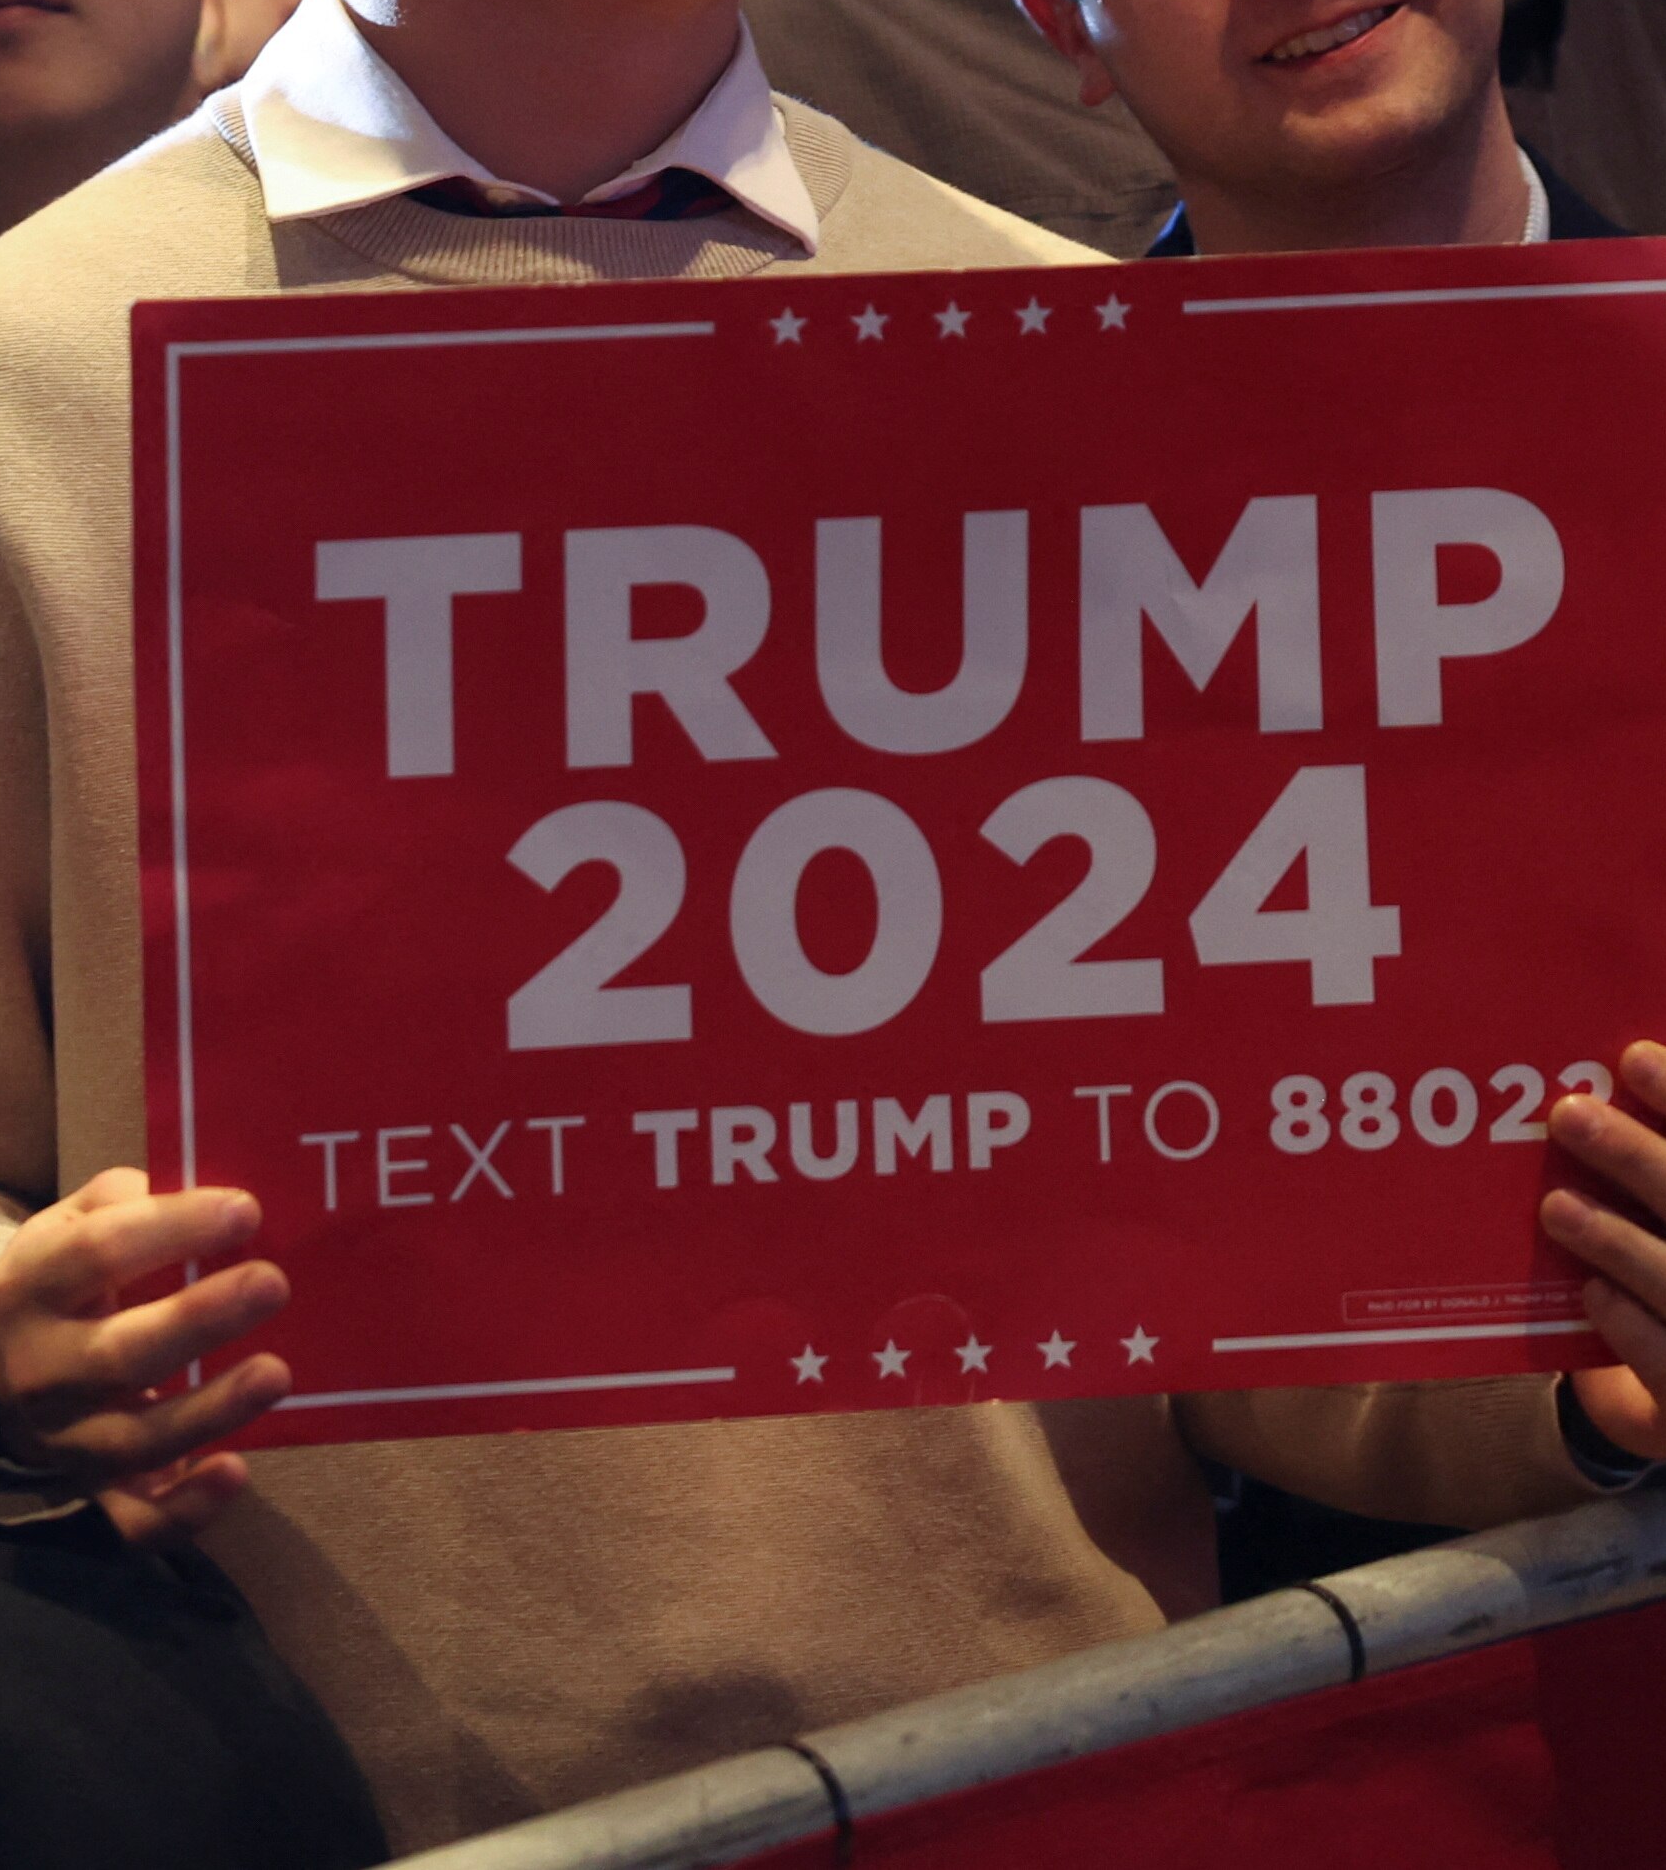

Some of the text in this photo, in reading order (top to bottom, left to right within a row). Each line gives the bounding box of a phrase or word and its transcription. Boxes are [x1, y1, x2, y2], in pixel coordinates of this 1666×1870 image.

[316, 487, 1565, 778] TRUMP
[507, 764, 1401, 1050] 2024
[301, 1117, 586, 1209] TEXT
[633, 1091, 1032, 1188] TRUMP
[1074, 1081, 1219, 1162] TO
